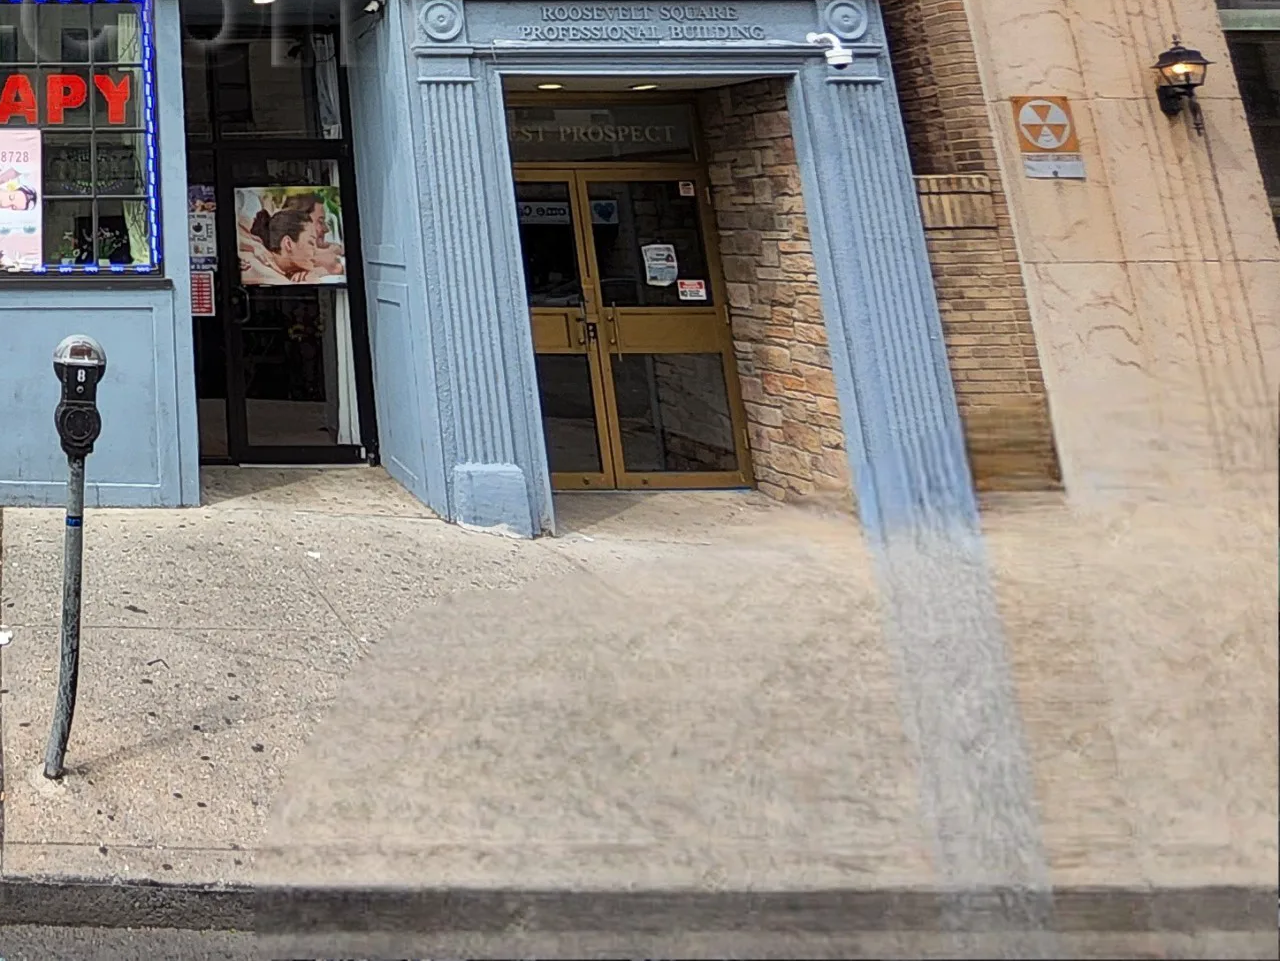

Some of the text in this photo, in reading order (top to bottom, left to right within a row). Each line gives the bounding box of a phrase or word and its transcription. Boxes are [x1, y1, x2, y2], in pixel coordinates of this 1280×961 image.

[540, 5, 738, 21] ROOSEVELT SQUARE
[519, 24, 765, 41] PROFESSIONAL BUILDING
[559, 124, 677, 142] PROSPECT
